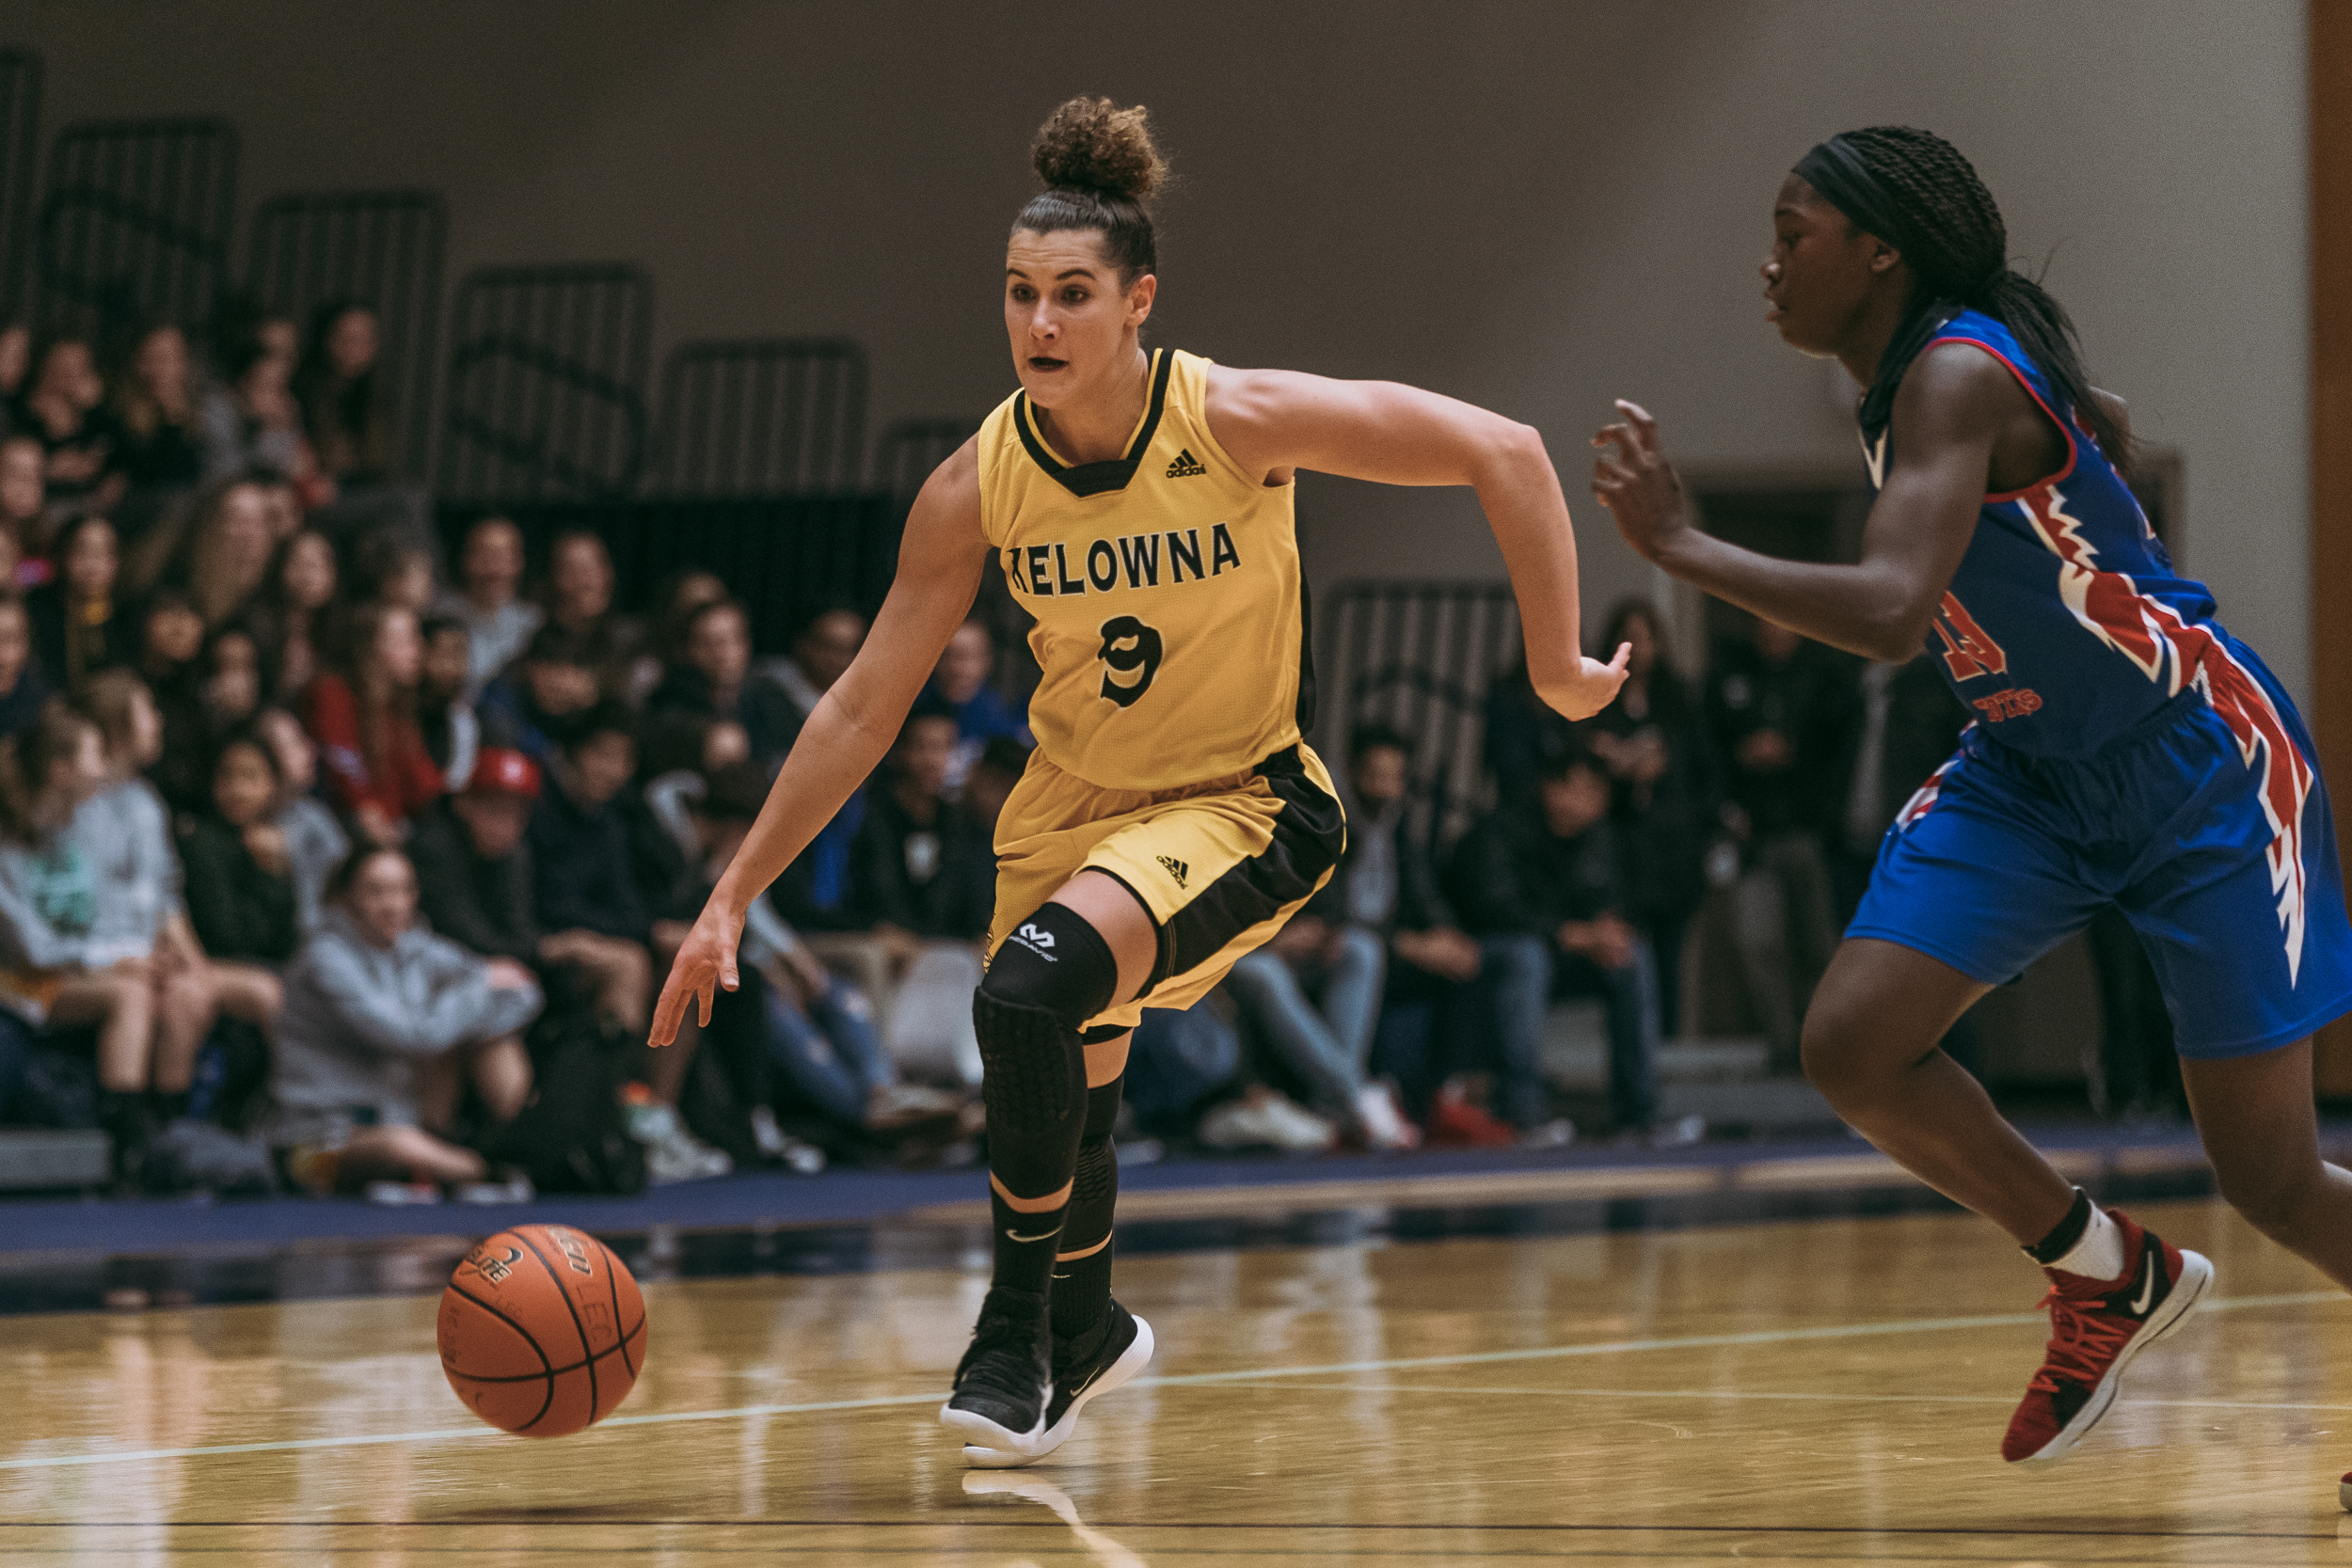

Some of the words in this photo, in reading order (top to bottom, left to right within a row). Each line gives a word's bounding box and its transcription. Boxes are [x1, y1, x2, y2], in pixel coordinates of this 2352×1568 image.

[1165, 463, 1207, 479] adidas
[1005, 522, 1242, 597] KELOWNA
[1095, 613, 1167, 712] 9
[1155, 855, 1189, 891] adidas
